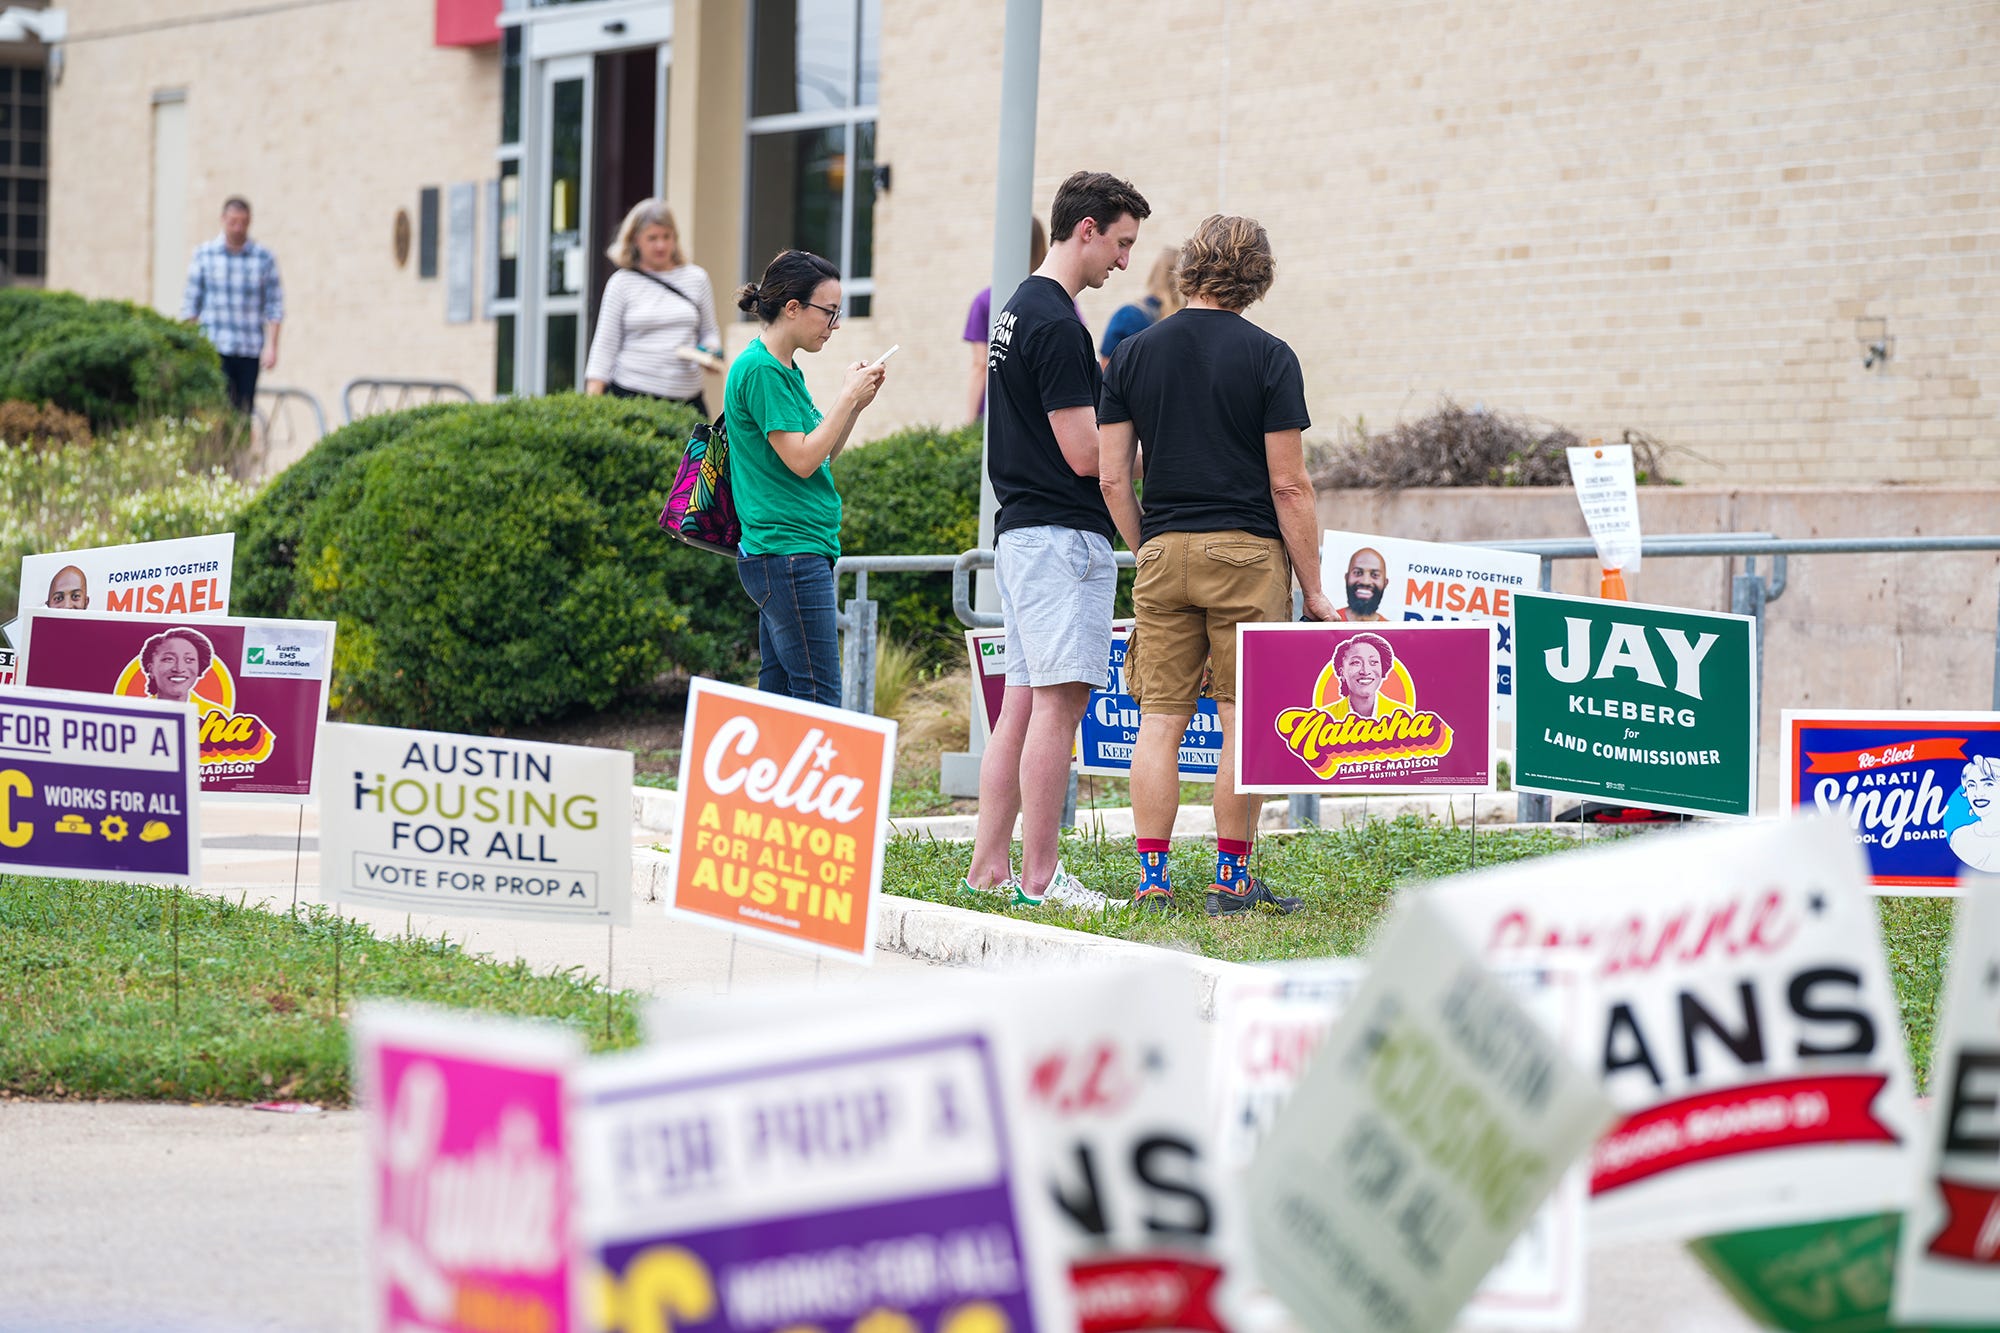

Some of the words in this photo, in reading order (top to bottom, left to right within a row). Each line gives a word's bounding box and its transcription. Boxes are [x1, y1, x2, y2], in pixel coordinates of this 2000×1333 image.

[108, 567, 162, 584] FORWARD
[165, 560, 219, 577] TOGETHER
[1408, 563, 1463, 578] FORWARD
[1466, 570, 1523, 585] TOGETHER
[107, 577, 224, 614] MISAEL
[1405, 578, 1509, 617] MISAE
[265, 659, 310, 667] Association
[1544, 616, 1720, 700] JAY
[1568, 694, 1696, 728] KLEBERG
[0, 713, 50, 747] FOR
[63, 719, 136, 754] PROP
[151, 727, 170, 757] A
[1277, 710, 1434, 761] Natasha
[1544, 727, 1587, 753] LAND
[1592, 742, 1721, 767] COMMISSIONER
[1623, 727, 1640, 740] for
[402, 742, 552, 783] AUSTIN
[703, 715, 864, 823] Celia
[1177, 752, 1220, 764] MENTU
[1339, 757, 1439, 775] HARPER-MADISON
[1858, 744, 1915, 768] Re-Elect
[1369, 770, 1398, 780] AUSTIN
[1862, 771, 1917, 786] ARATI
[44, 785, 107, 810] WORKS
[111, 790, 145, 813] FOR
[148, 793, 181, 815] ALL
[354, 771, 598, 831] HOUSING
[392, 821, 470, 856] FOR
[486, 831, 558, 863] ALL
[697, 802, 721, 830] A
[733, 808, 857, 863] MAYOR
[1855, 833, 1879, 844] OOL
[1904, 830, 1948, 841] BOARD
[695, 830, 748, 862] FOR
[757, 847, 810, 877] ALL
[819, 861, 855, 886] OF
[364, 862, 426, 888] VOTE
[437, 871, 486, 892] FOR
[495, 876, 560, 897] PROP
[568, 880, 587, 899] A
[691, 857, 853, 925] AUSTIN
[1603, 965, 1876, 1088] ANS
